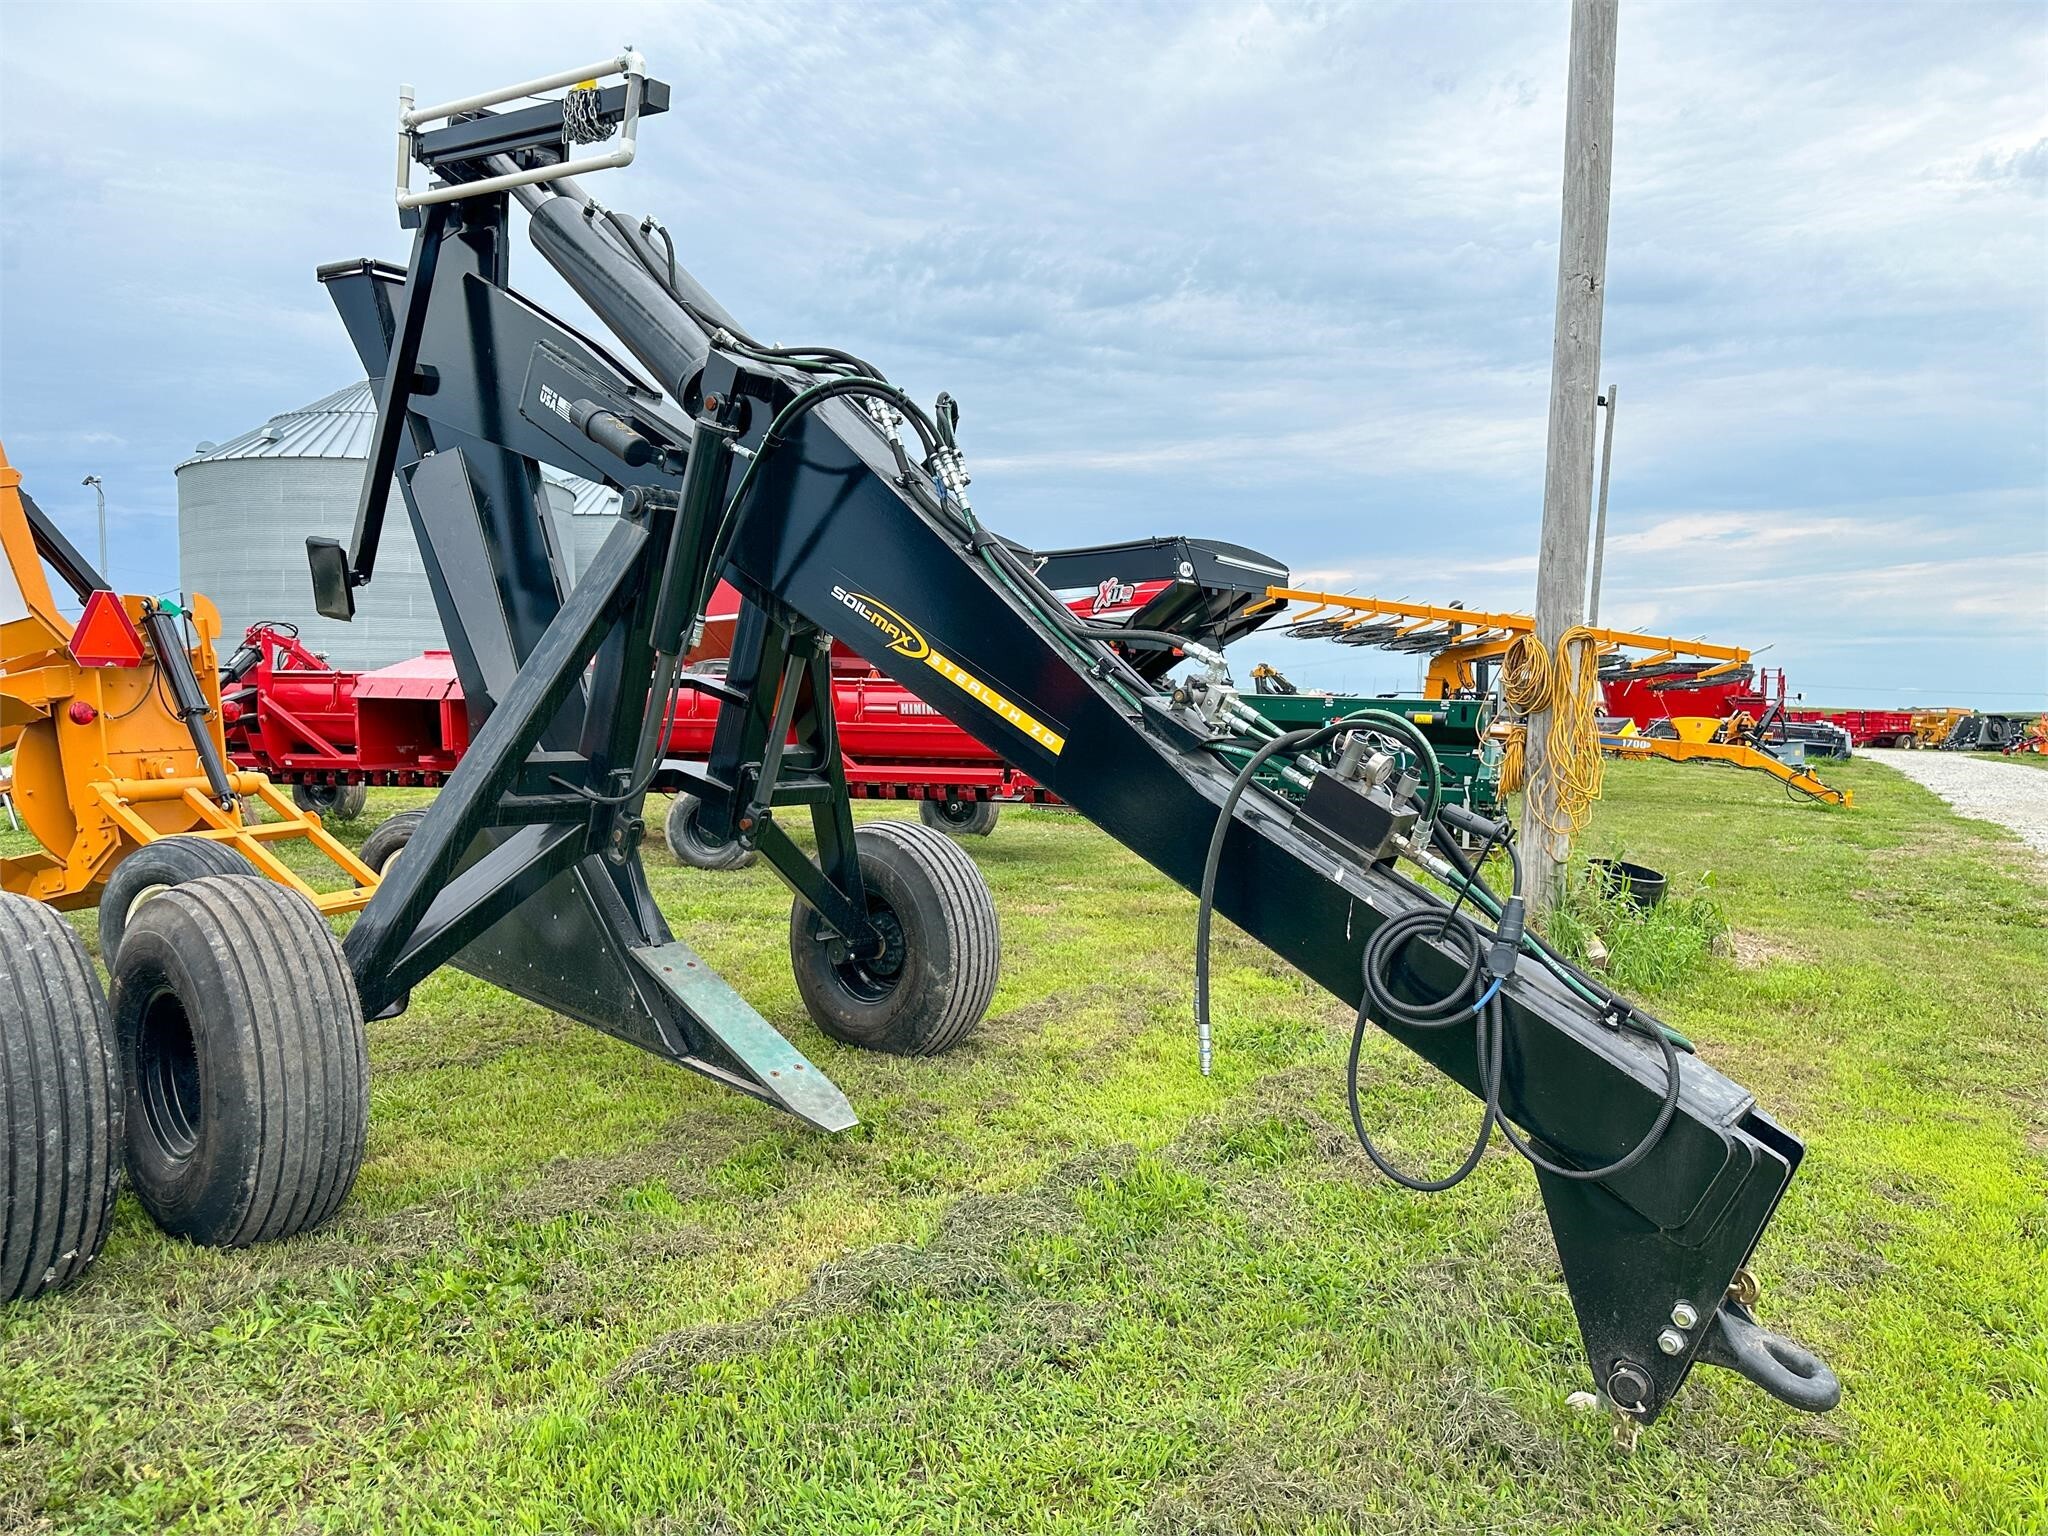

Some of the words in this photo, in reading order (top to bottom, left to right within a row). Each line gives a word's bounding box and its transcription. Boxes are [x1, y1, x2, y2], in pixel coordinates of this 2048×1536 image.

[540, 390, 556, 411] USA
[830, 585, 914, 648] SOIL-MAX
[930, 655, 1021, 722] STEALTH
[1622, 739, 1647, 749] 1700
